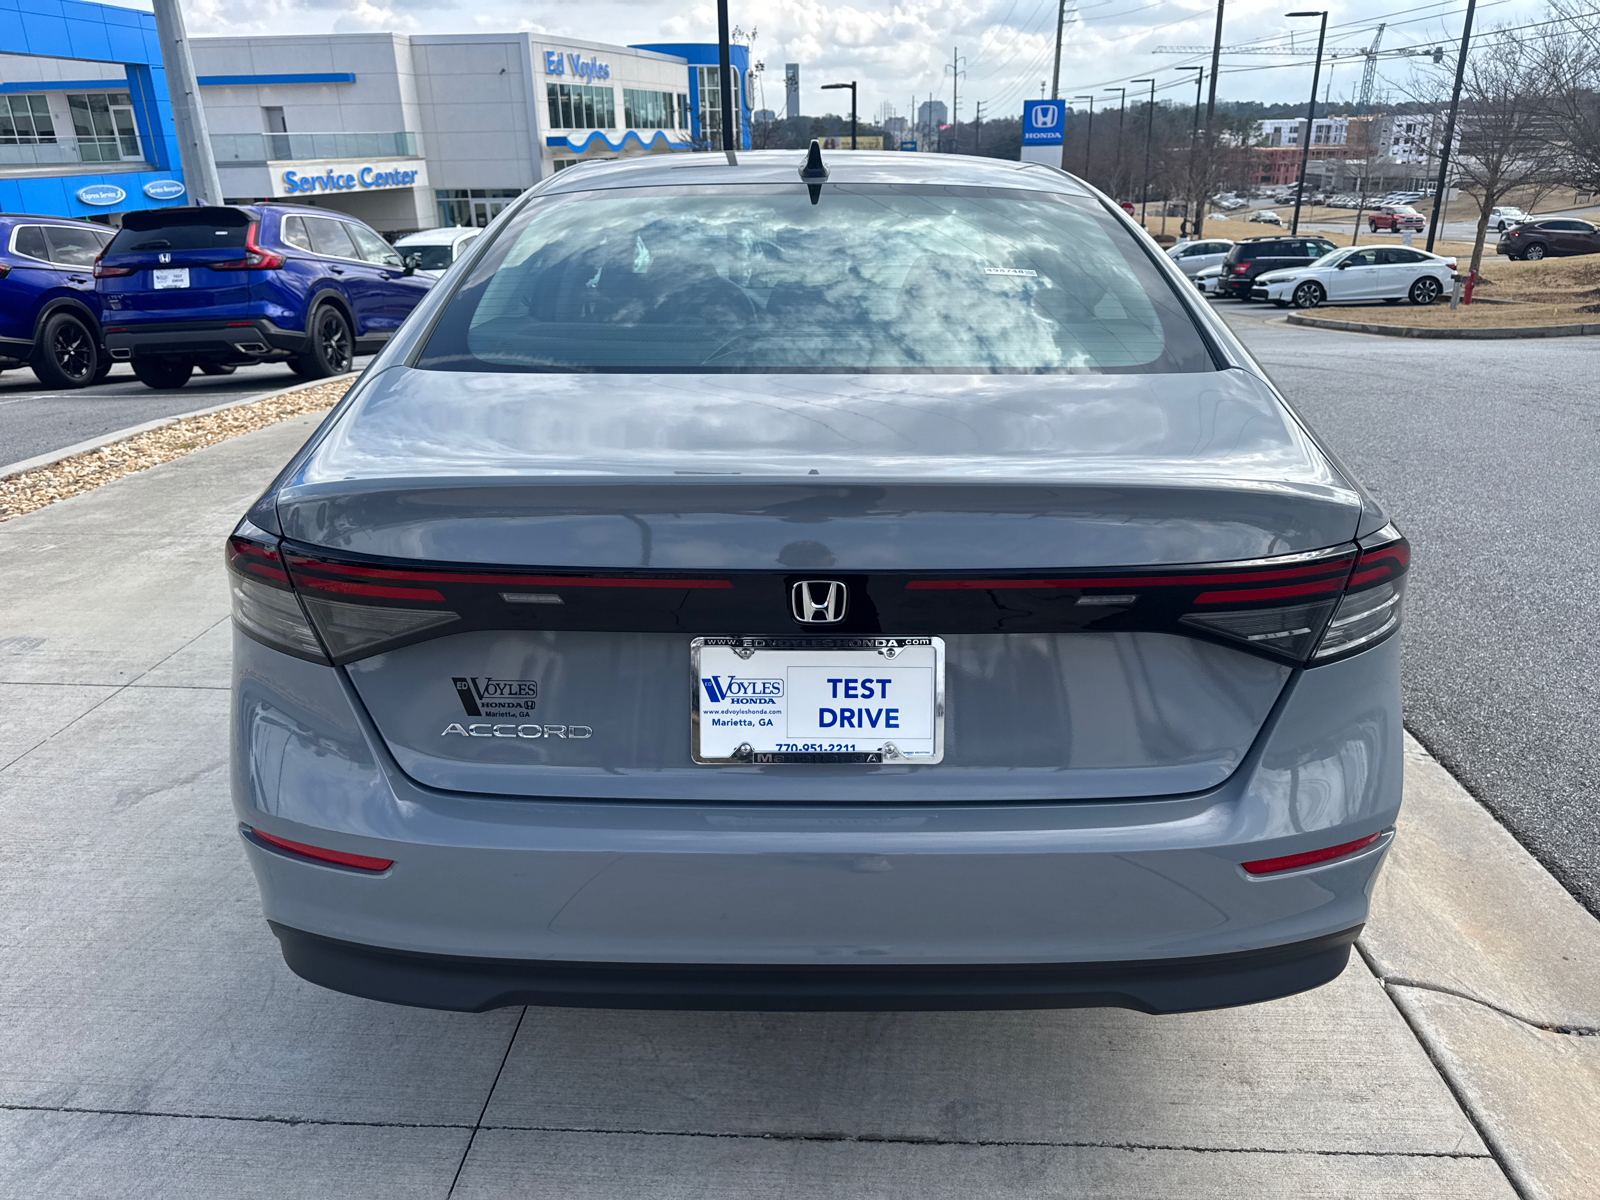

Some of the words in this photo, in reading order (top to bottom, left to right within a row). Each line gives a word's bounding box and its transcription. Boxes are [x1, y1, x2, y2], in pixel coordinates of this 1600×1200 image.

[544, 51, 565, 75] Ed
[568, 53, 610, 84] Voyles
[284, 168, 357, 193] Service
[359, 166, 418, 188] Center
[99, 191, 116, 199] Service
[456, 681, 468, 690] ED
[470, 677, 536, 700] VOYLES
[711, 676, 781, 701] VOYLES
[826, 678, 892, 699] TEST
[485, 711, 518, 719] Marietta,
[711, 718, 755, 727] Marietta,
[758, 718, 774, 727] GA
[819, 707, 900, 729] DRIVE
[440, 723, 593, 739] ACCORD
[775, 743, 856, 751] 770-951-2211
